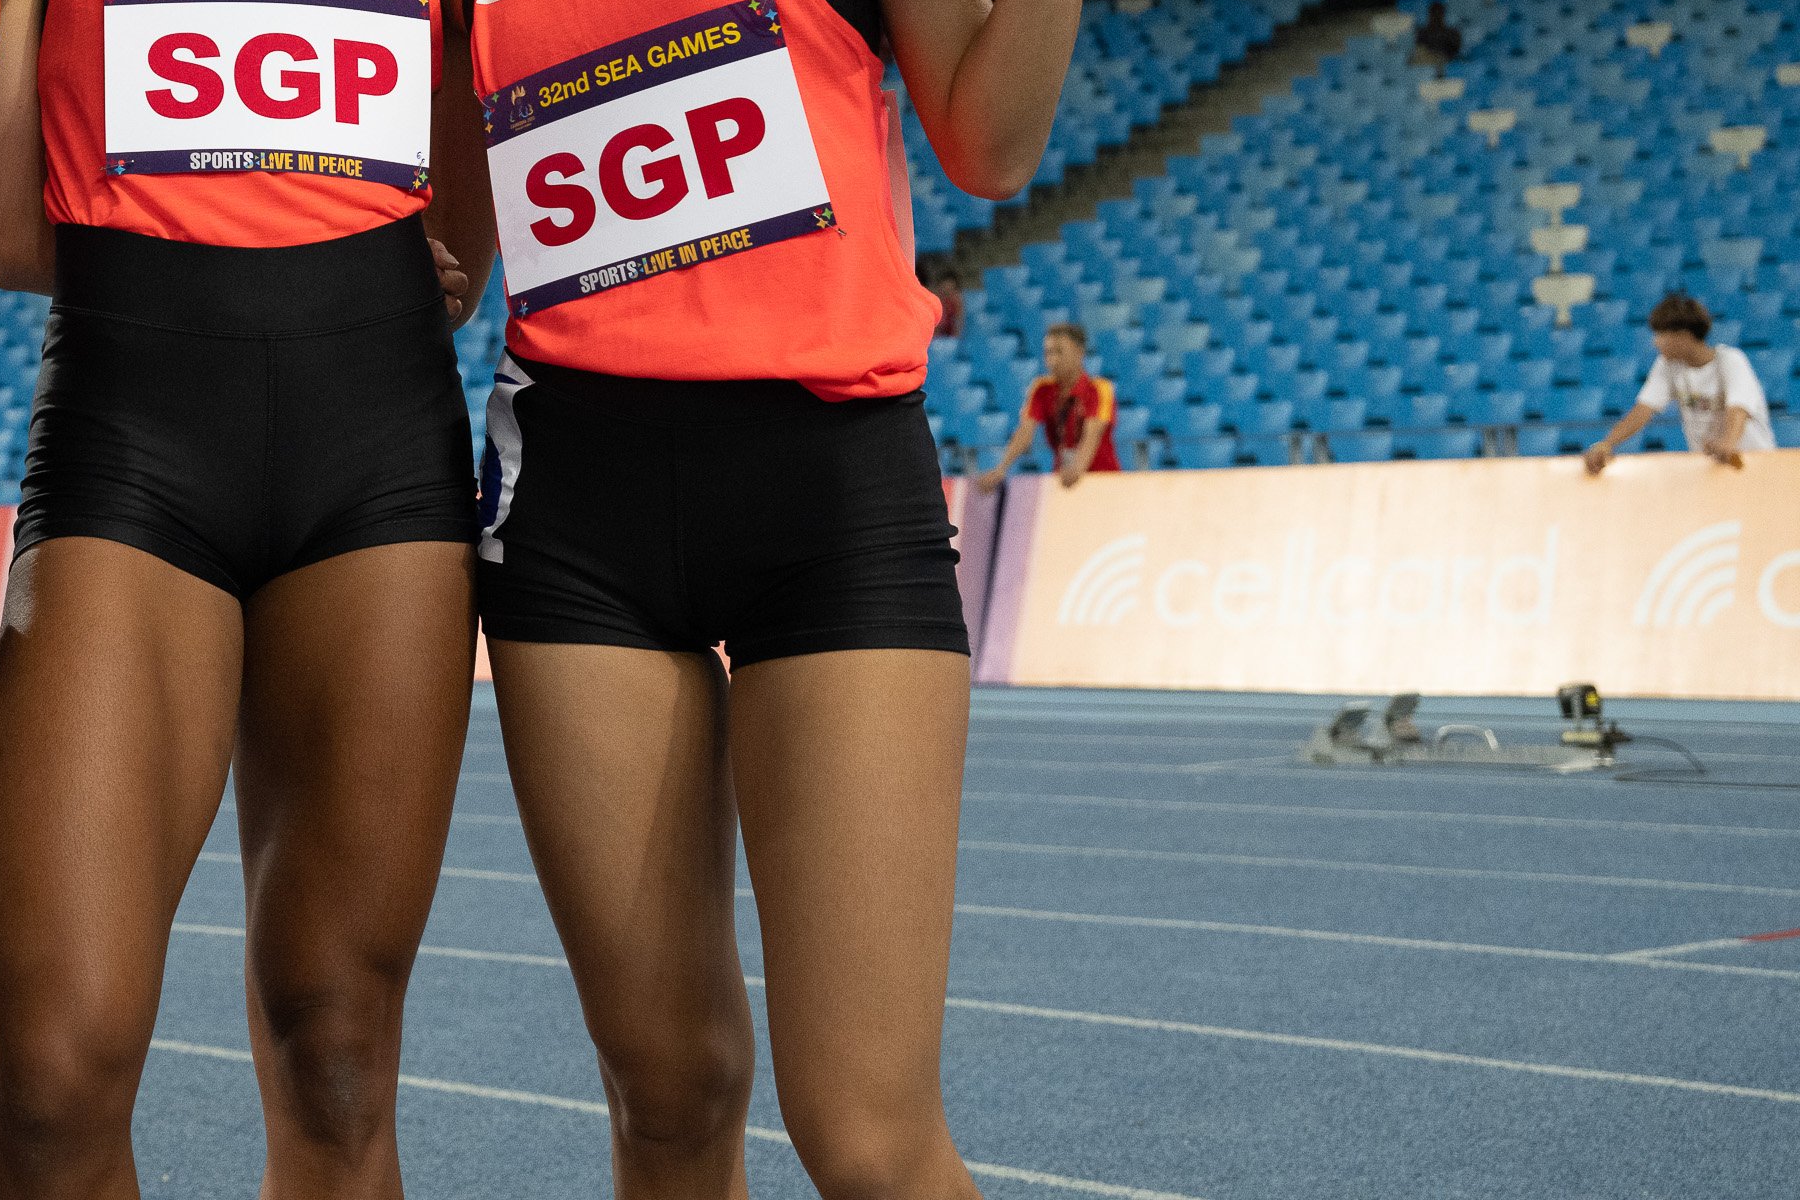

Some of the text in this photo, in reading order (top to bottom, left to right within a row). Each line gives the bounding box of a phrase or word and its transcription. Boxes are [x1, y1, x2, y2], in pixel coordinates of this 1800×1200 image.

[145, 32, 399, 125] SGP
[538, 21, 742, 108] 32nd SEA GAMES
[298, 154, 314, 172] IN
[319, 155, 363, 177] PEACE
[525, 97, 766, 247] SGP
[679, 243, 699, 264] IN
[699, 228, 753, 258] PEACE
[1154, 523, 1559, 629] cellcard
